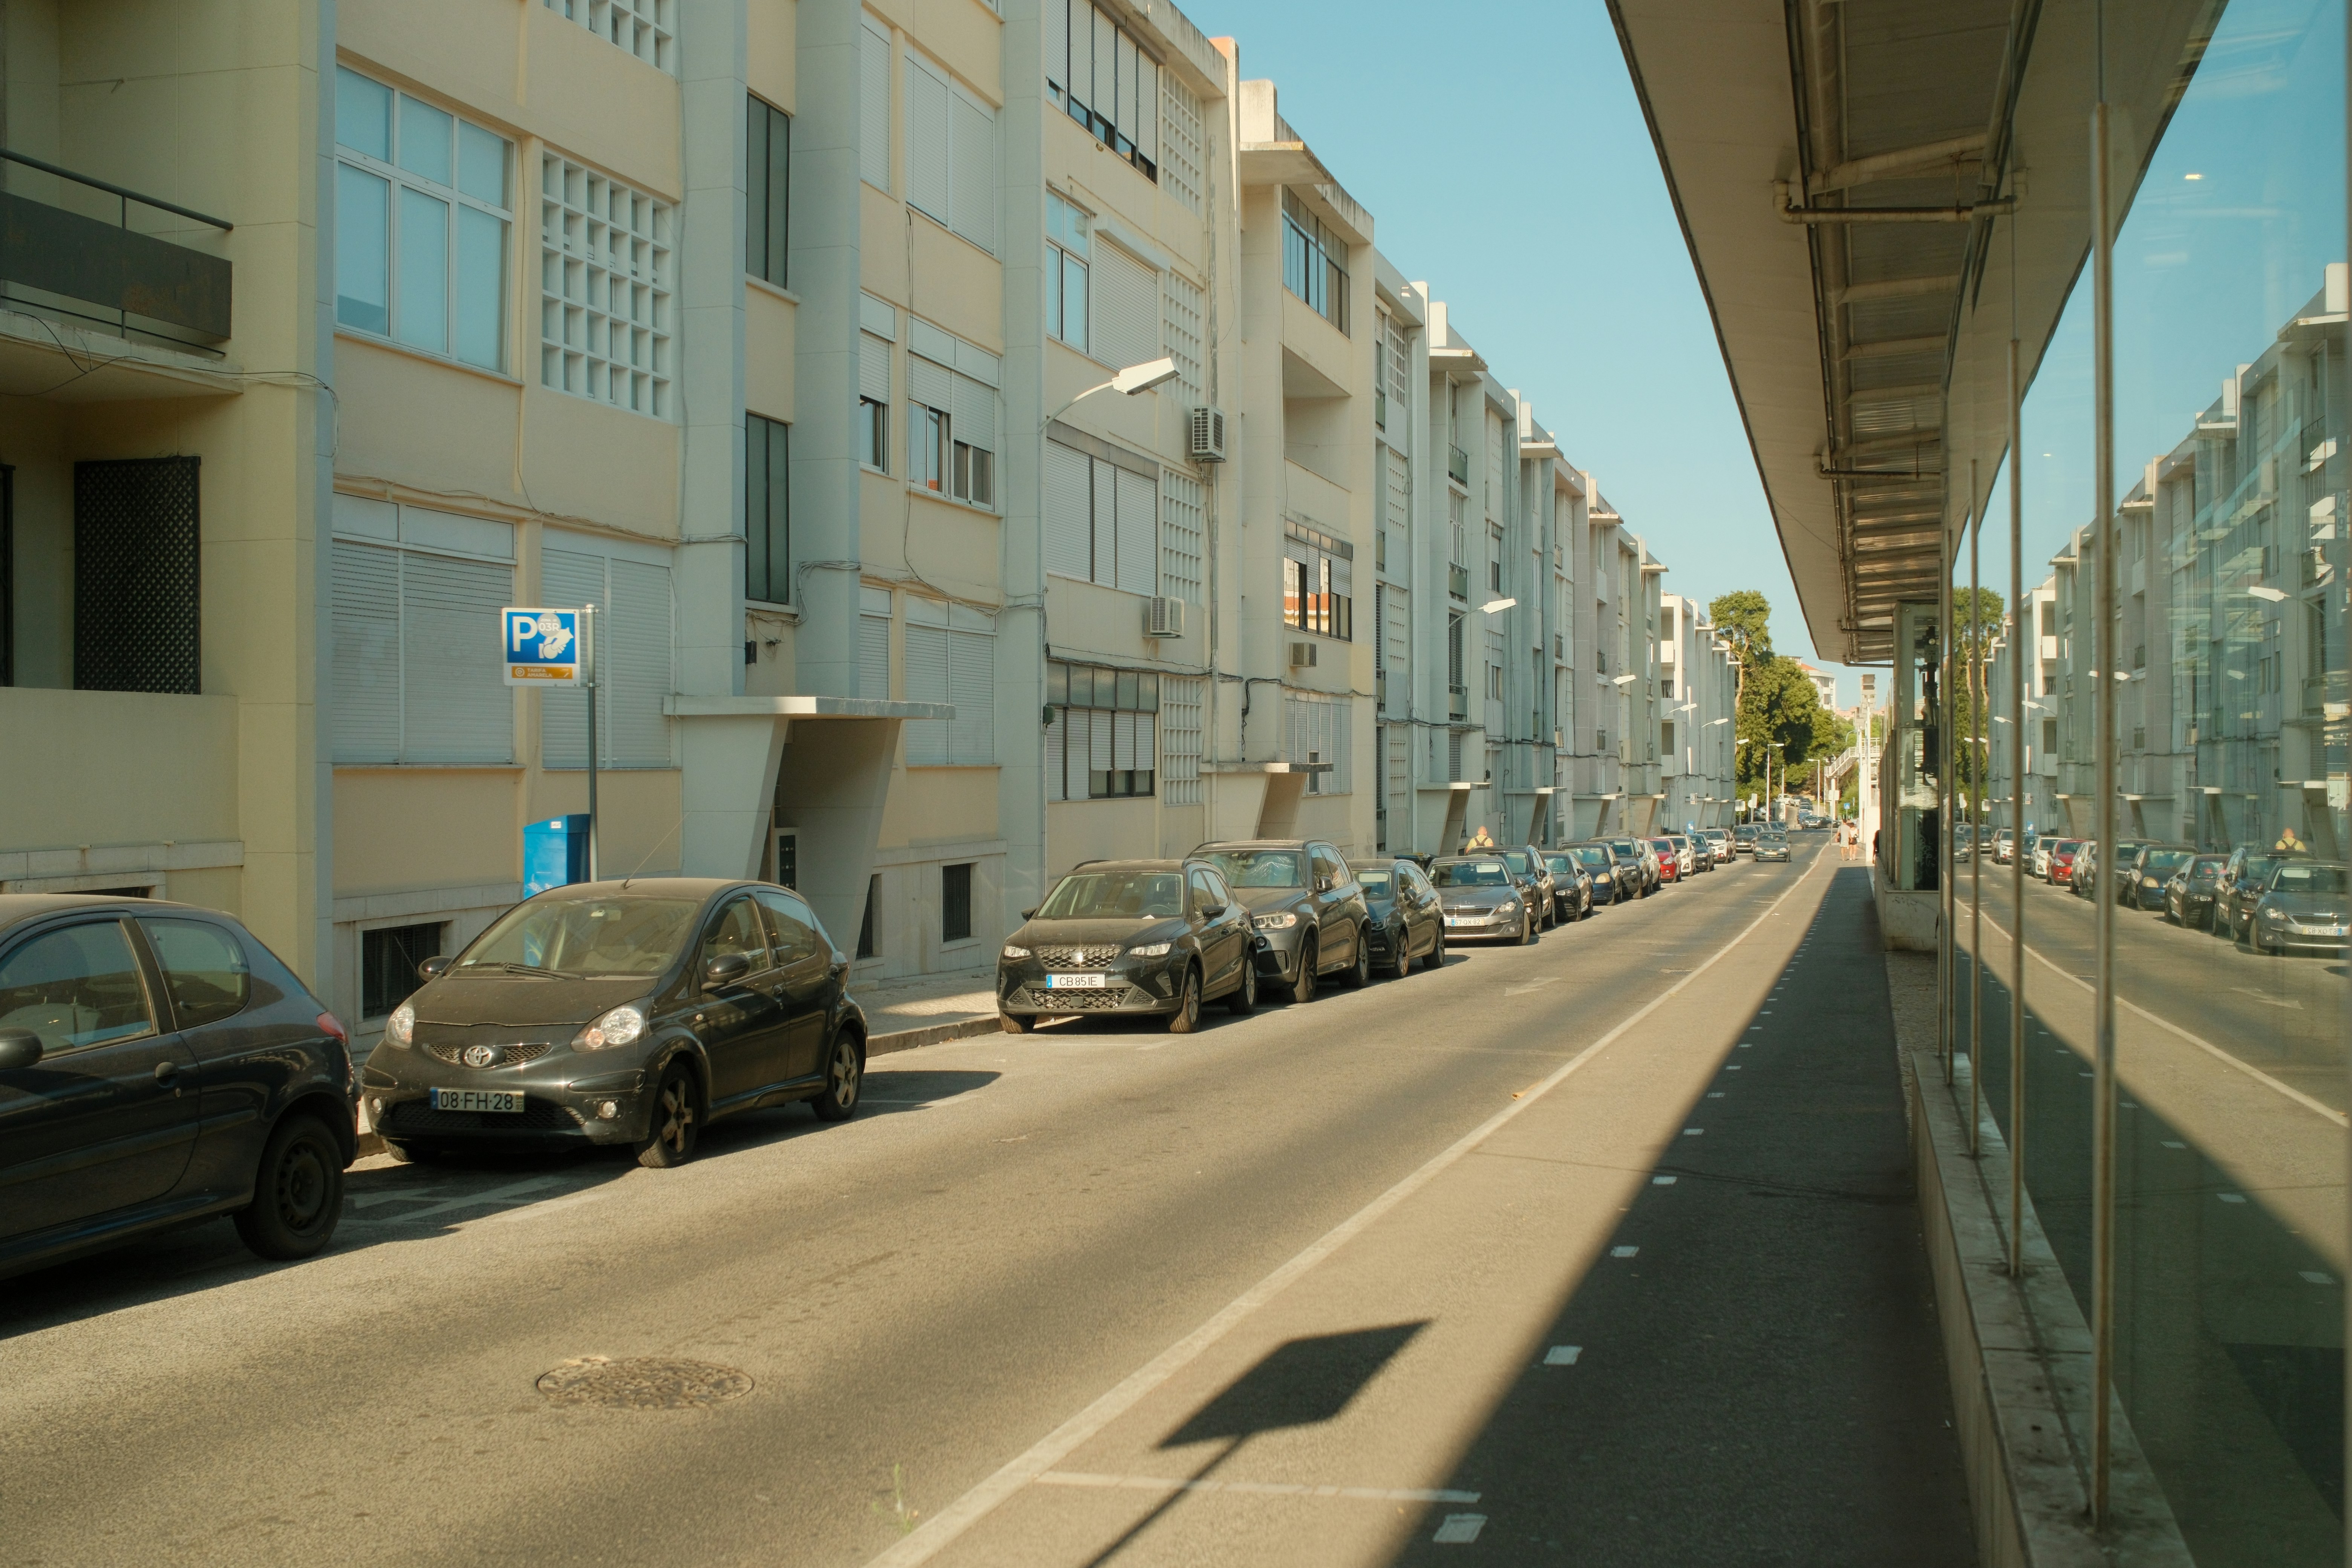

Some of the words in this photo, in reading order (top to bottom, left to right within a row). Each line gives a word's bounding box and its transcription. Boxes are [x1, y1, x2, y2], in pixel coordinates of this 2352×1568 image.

[539, 623, 559, 631] 03R
[513, 616, 538, 652] P
[1060, 977, 1073, 986] CB
[1075, 977, 1087, 986] 85
[1088, 977, 1097, 986] IE
